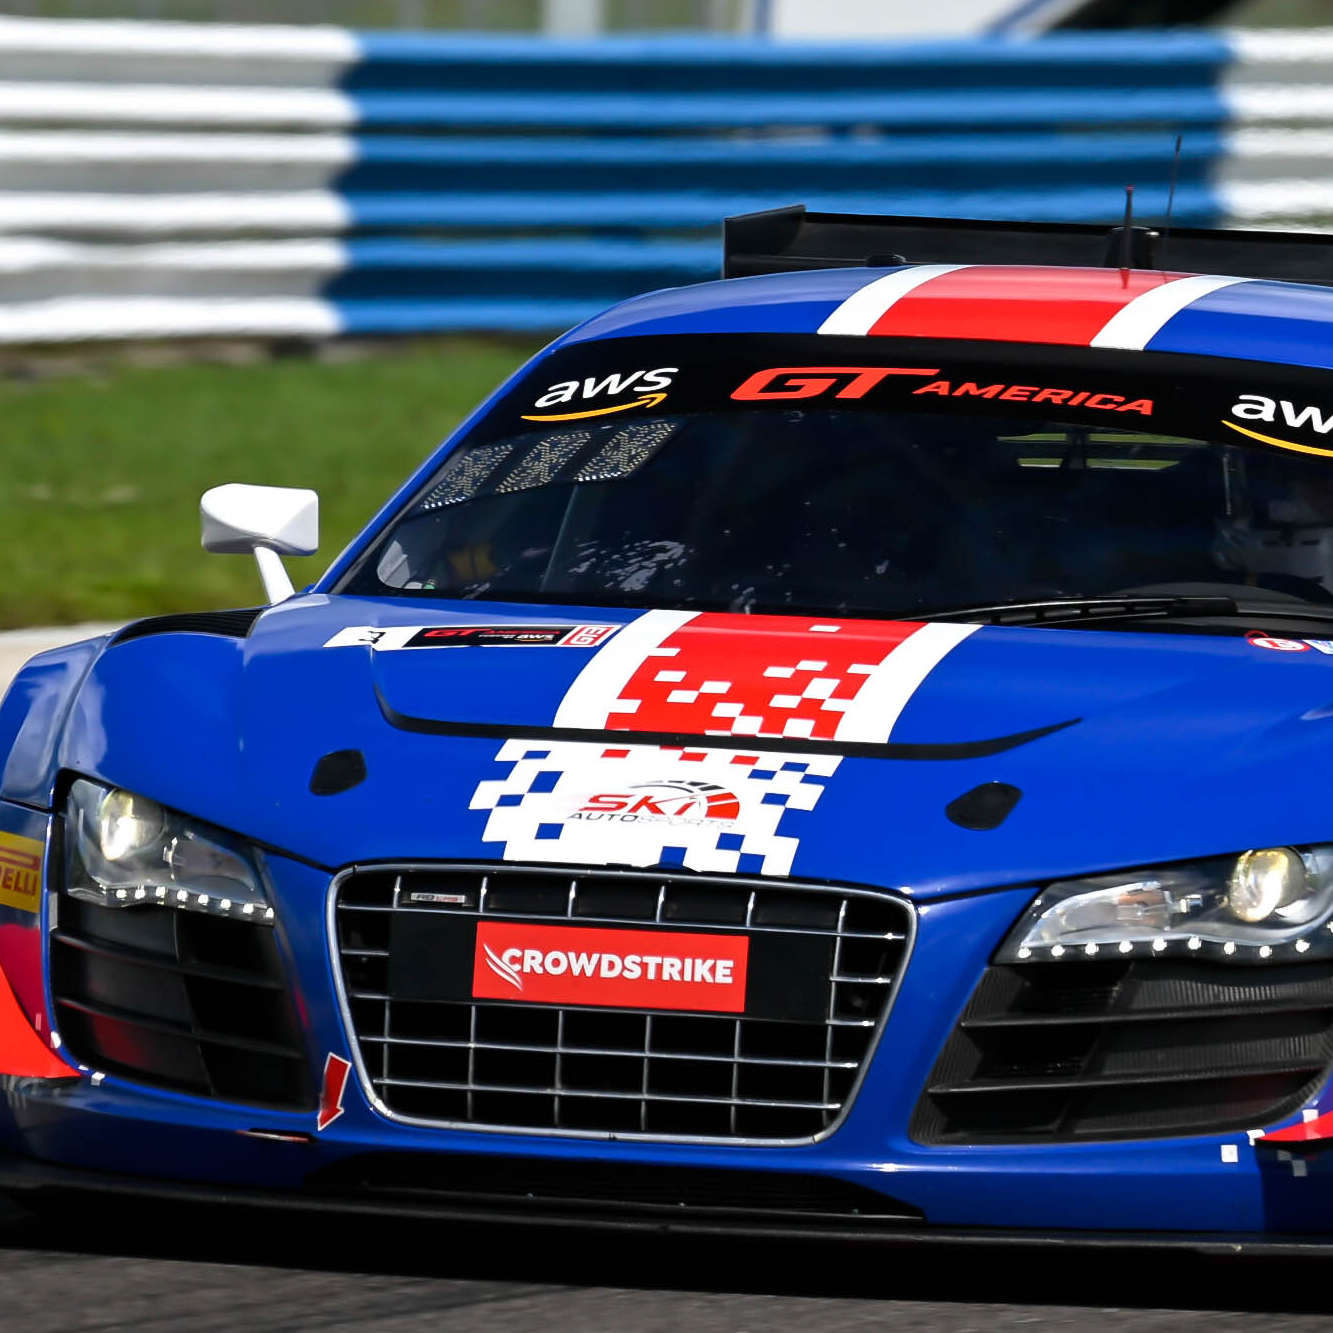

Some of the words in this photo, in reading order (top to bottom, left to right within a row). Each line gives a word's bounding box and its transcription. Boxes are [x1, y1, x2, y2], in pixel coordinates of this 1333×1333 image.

[533, 367, 679, 409] aws
[730, 366, 941, 401] GT
[912, 380, 1154, 416] AMERICA
[501, 948, 734, 984] CROWDSTRIKE
